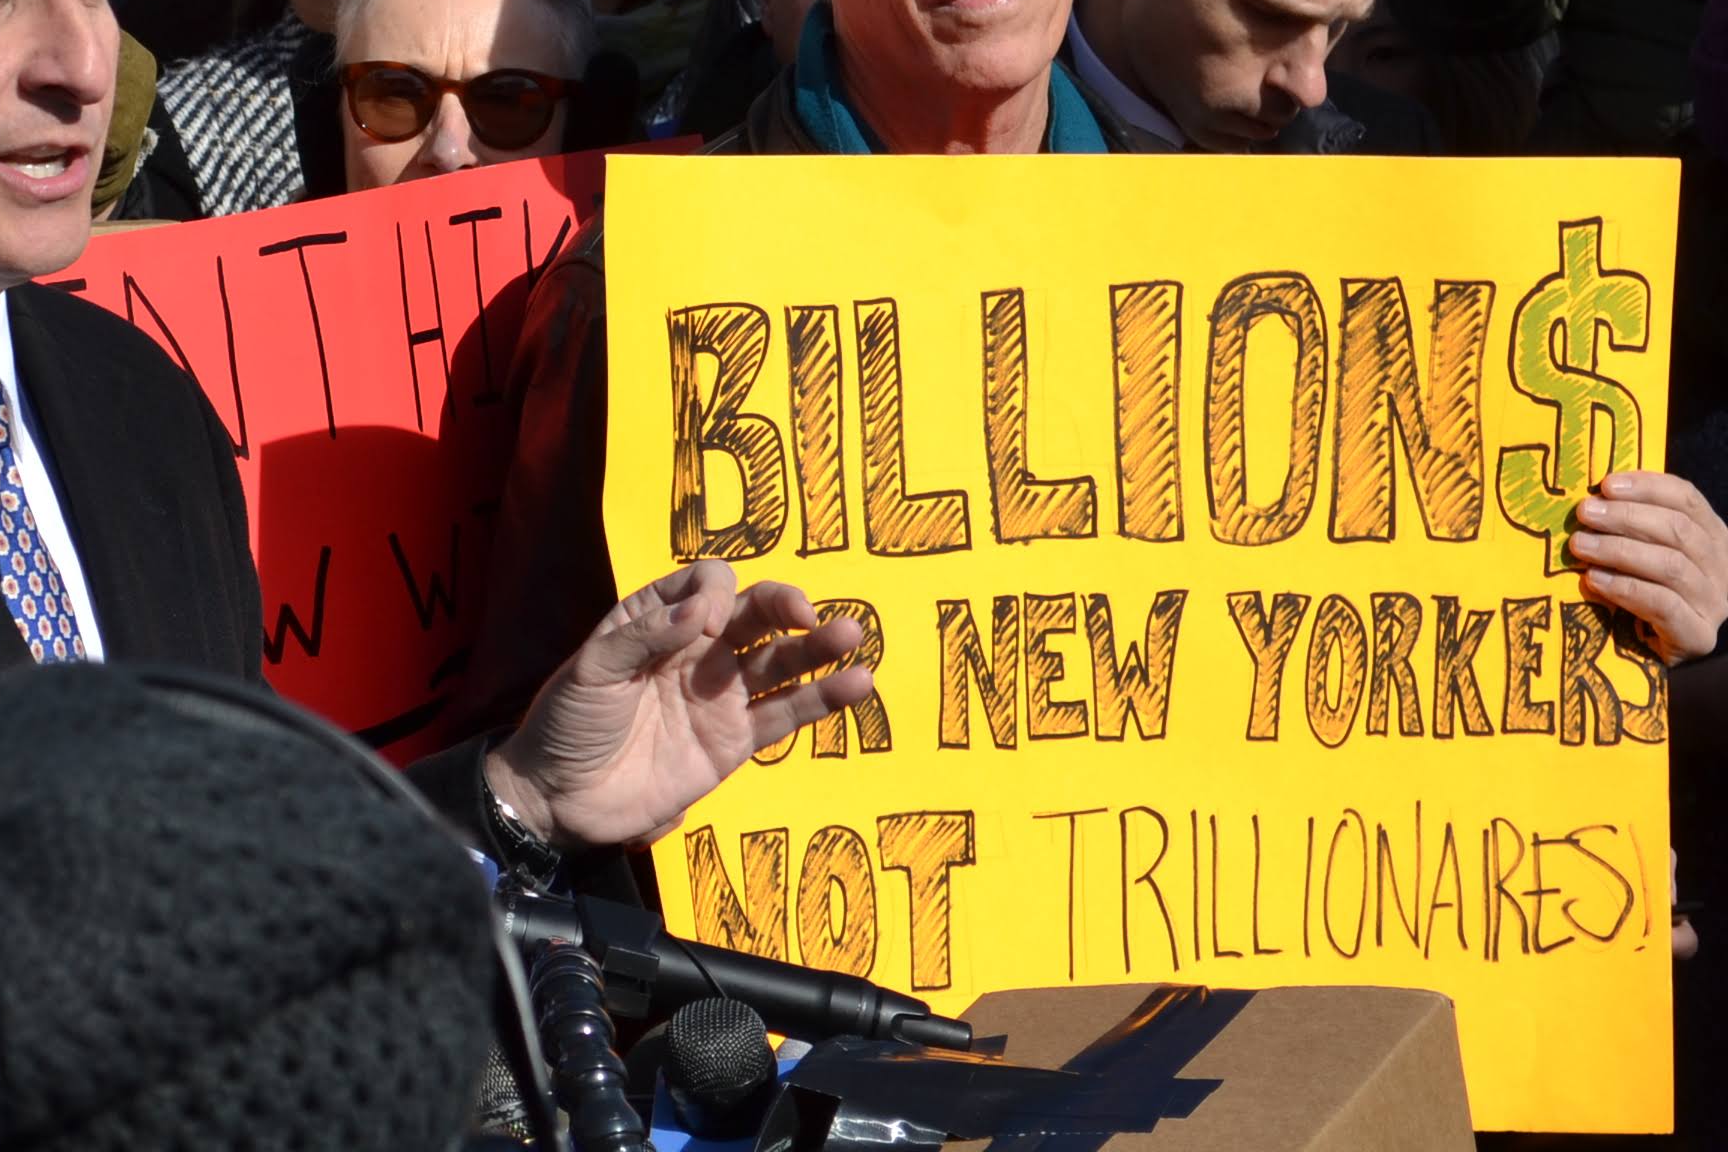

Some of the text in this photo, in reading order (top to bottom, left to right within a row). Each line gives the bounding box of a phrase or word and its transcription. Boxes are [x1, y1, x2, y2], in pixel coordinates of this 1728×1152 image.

[667, 216, 1652, 575] BILLION$
[936, 589, 1189, 750] NEW
[1227, 590, 1668, 748] YORKERS
[684, 809, 976, 992] NOT
